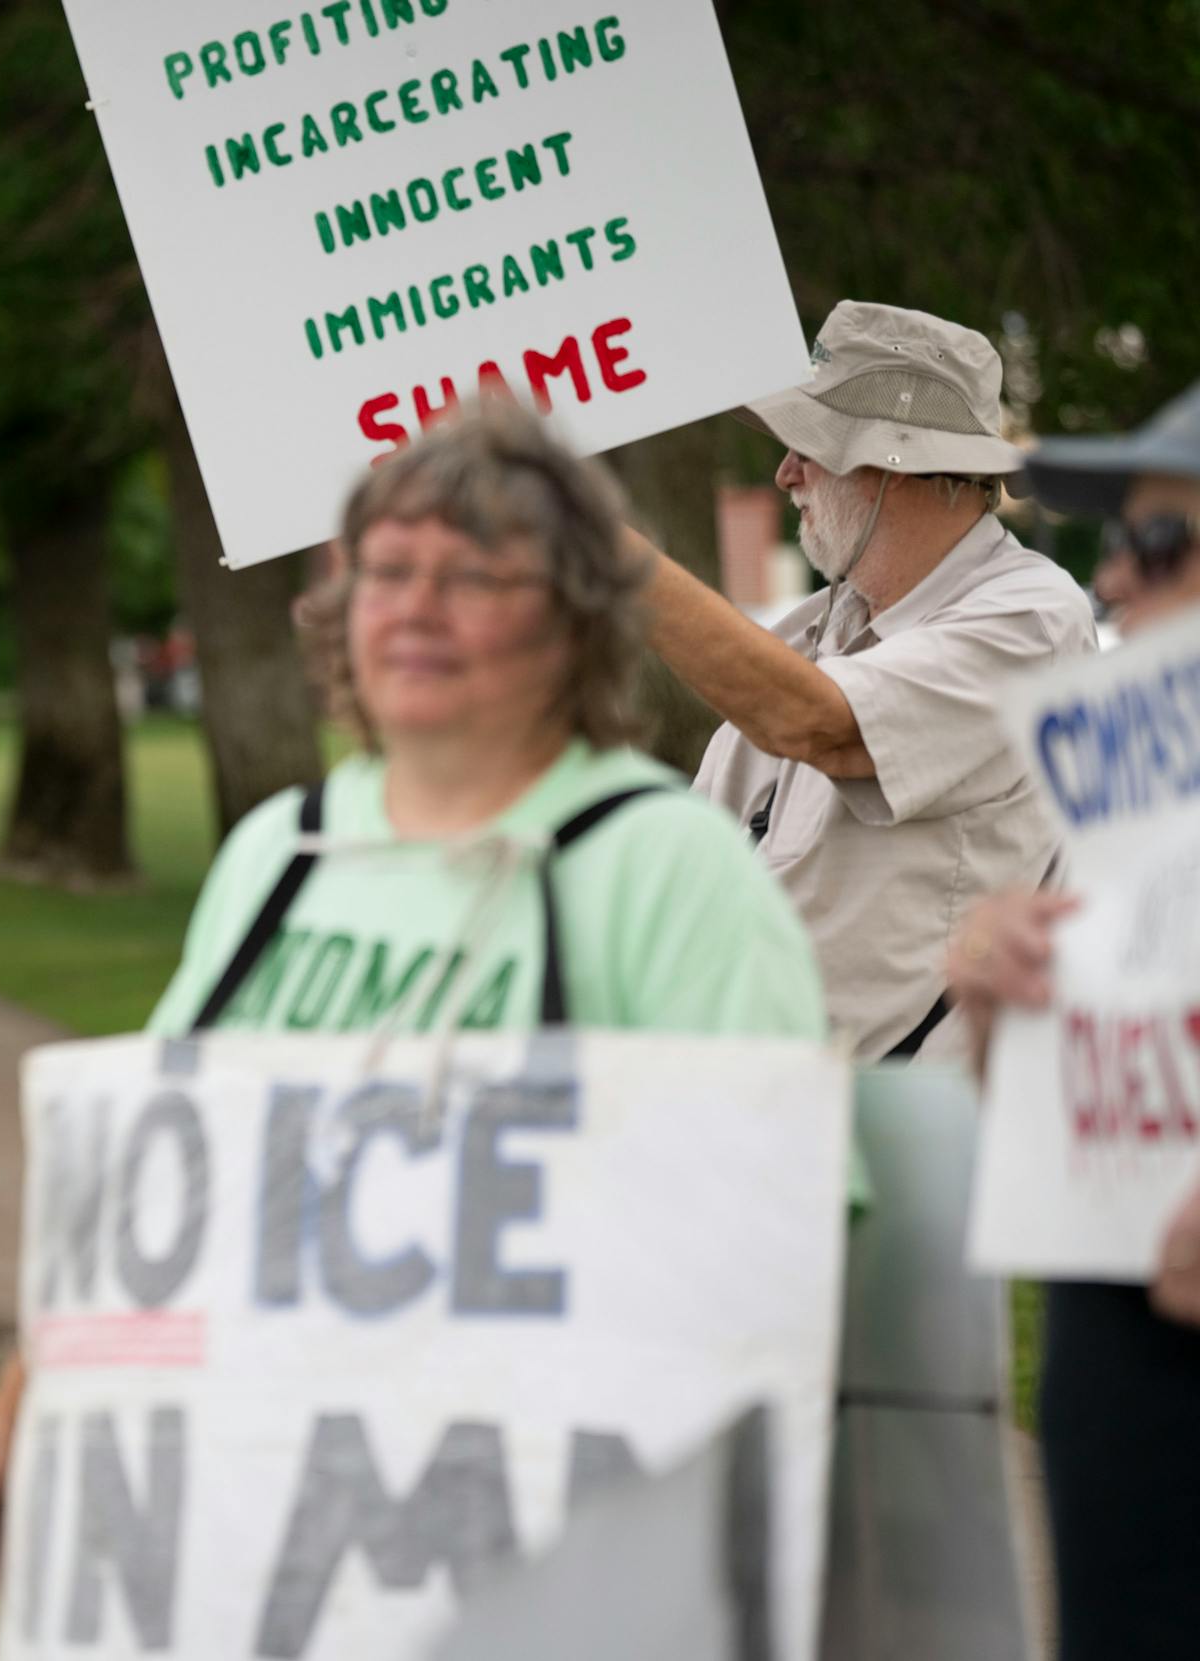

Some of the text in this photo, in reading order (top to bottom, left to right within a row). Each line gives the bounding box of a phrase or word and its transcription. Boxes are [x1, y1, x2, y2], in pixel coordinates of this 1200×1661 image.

[204, 16, 627, 187] INCARCERATING
[315, 131, 573, 254] INNOCENT
[304, 216, 638, 360] IMMIGRANTS
[40, 1078, 580, 1321] NO ICE
[21, 1404, 188, 1652] IN
